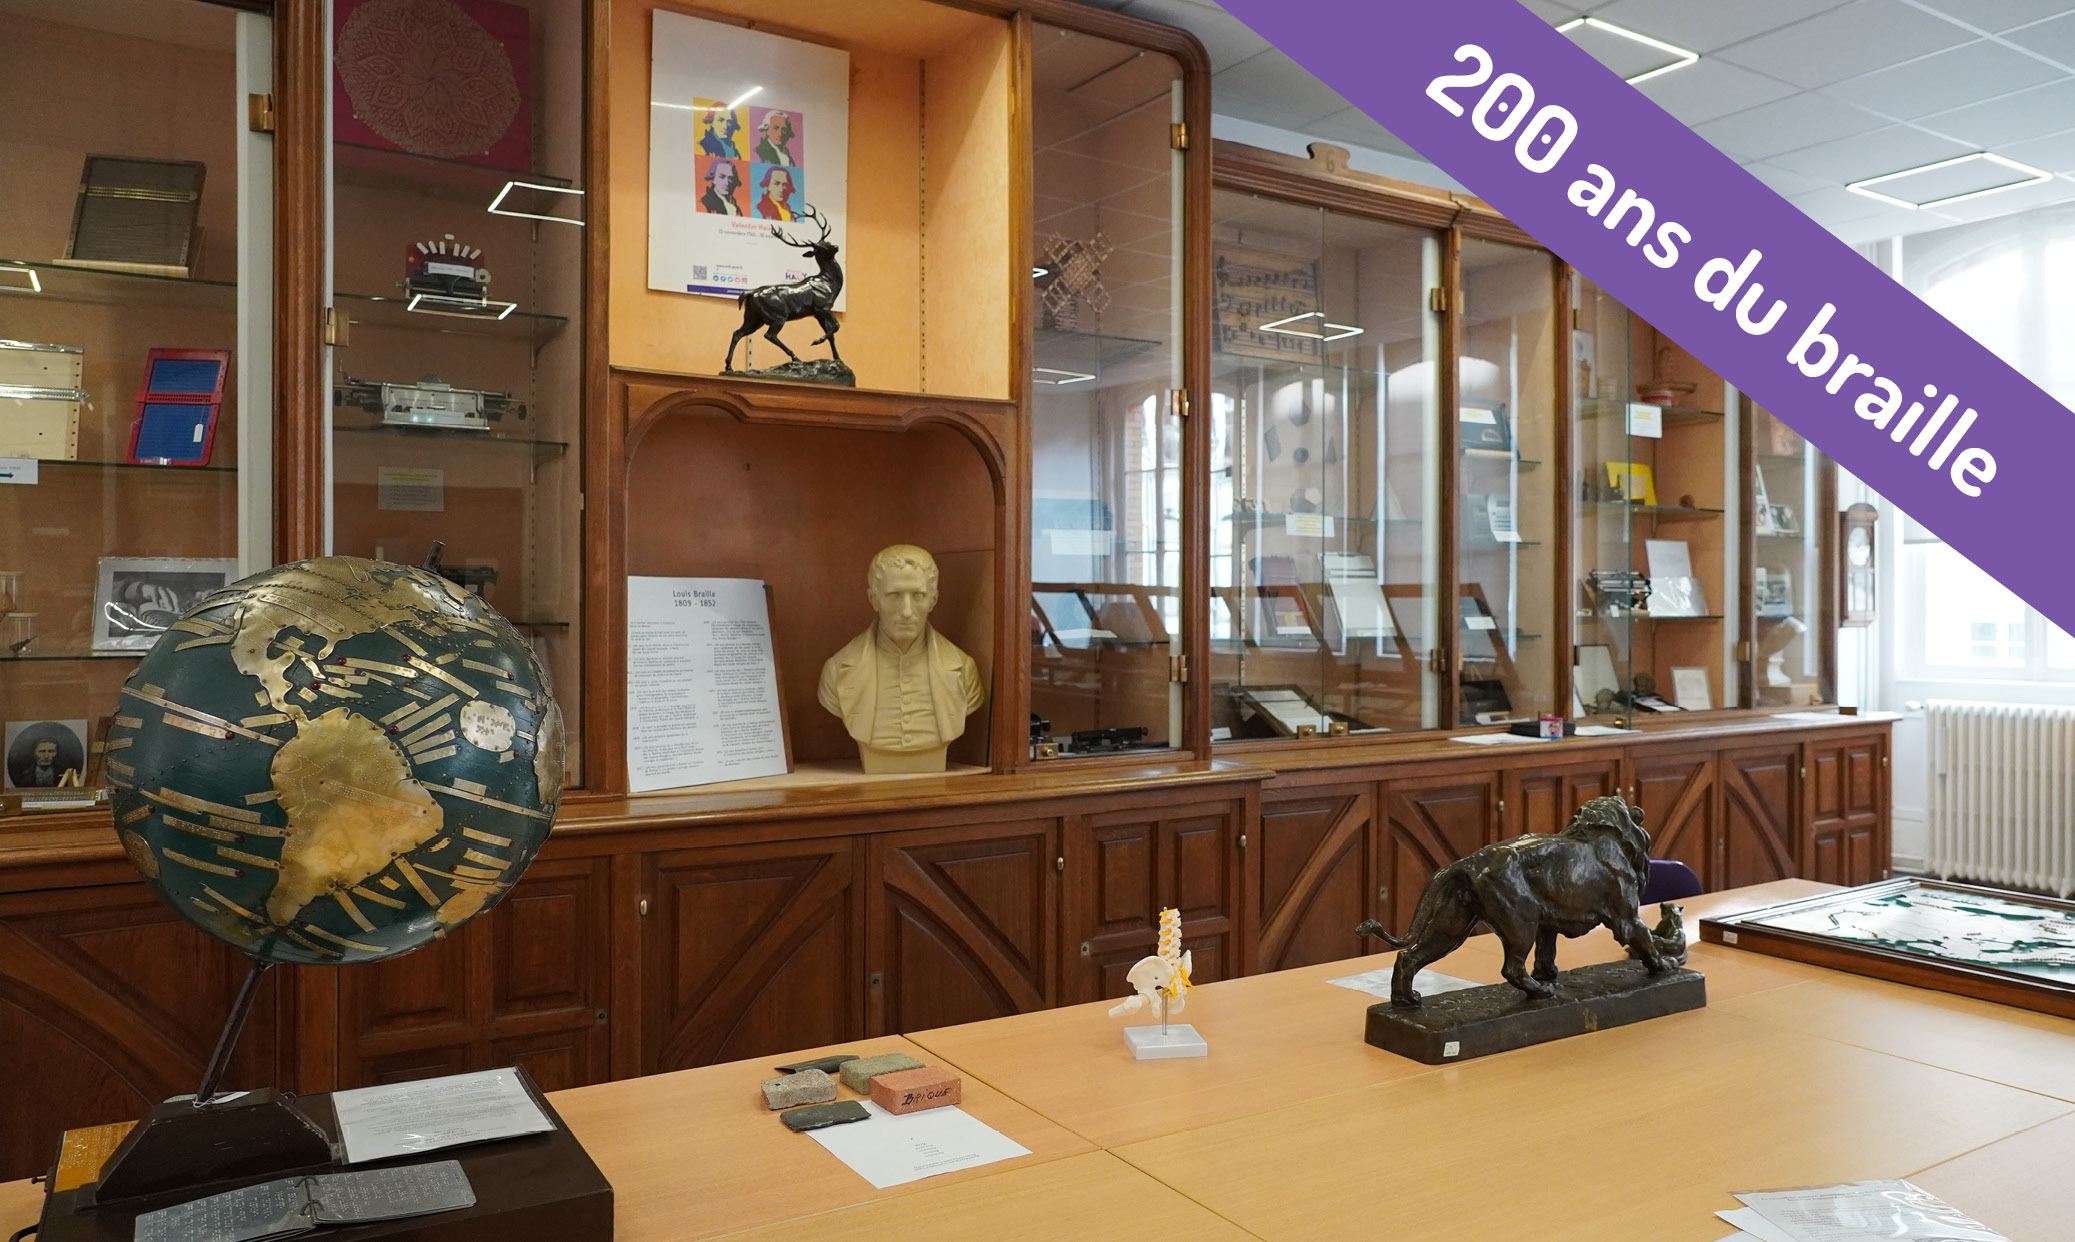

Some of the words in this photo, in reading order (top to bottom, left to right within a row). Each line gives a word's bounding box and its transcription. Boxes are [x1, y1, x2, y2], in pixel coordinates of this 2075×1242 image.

[731, 221, 757, 230] Valentin
[672, 589, 691, 598] Louis
[693, 589, 716, 598] Braille
[674, 599, 692, 607] 1809
[700, 599, 716, 607] 1852
[901, 1087, 951, 1106] BRIQUE
